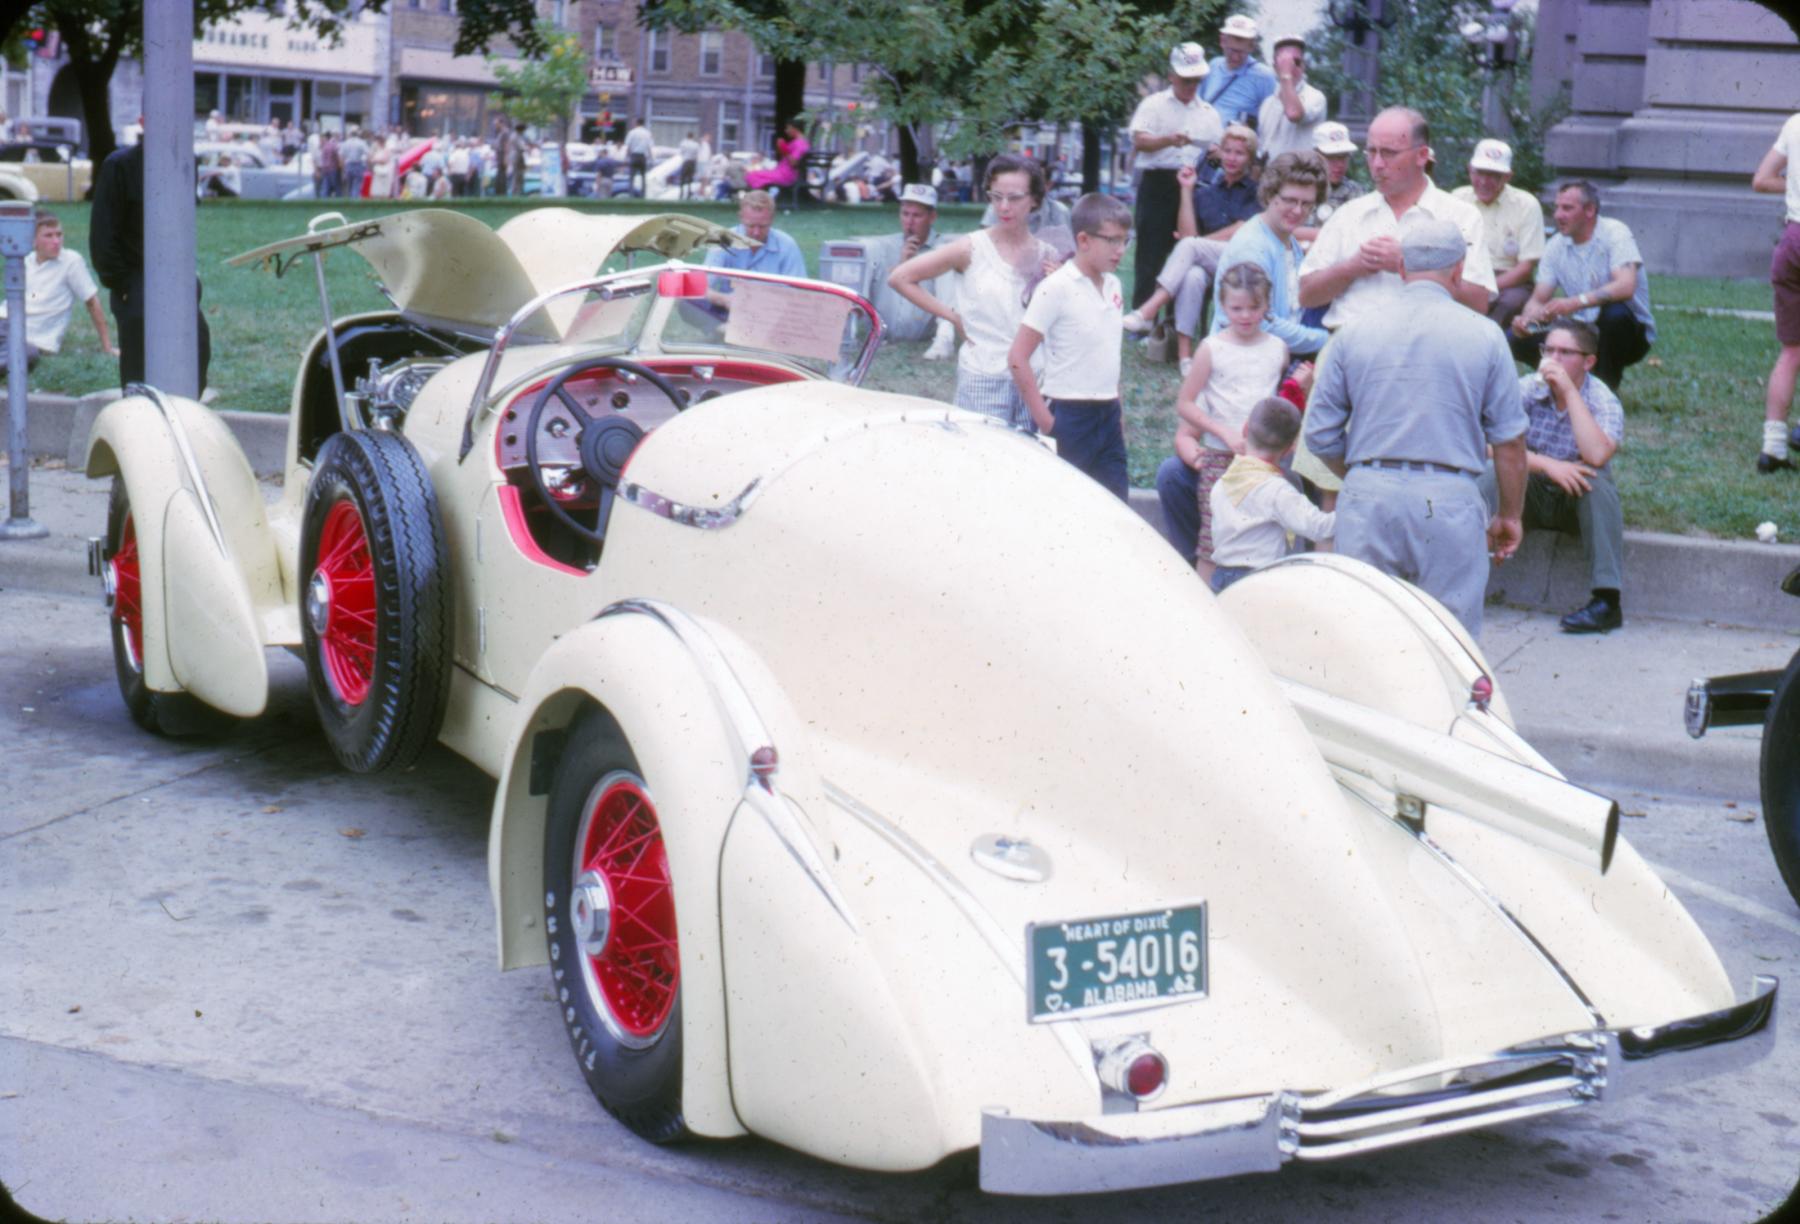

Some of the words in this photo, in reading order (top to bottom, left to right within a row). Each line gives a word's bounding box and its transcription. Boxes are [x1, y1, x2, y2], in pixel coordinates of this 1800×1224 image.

[207, 30, 269, 49] URANCE
[1065, 922, 1110, 942] HEART
[1113, 919, 1131, 936] OF
[1134, 915, 1169, 933] DIXIE
[1083, 981, 1158, 1006] ALABAMA
